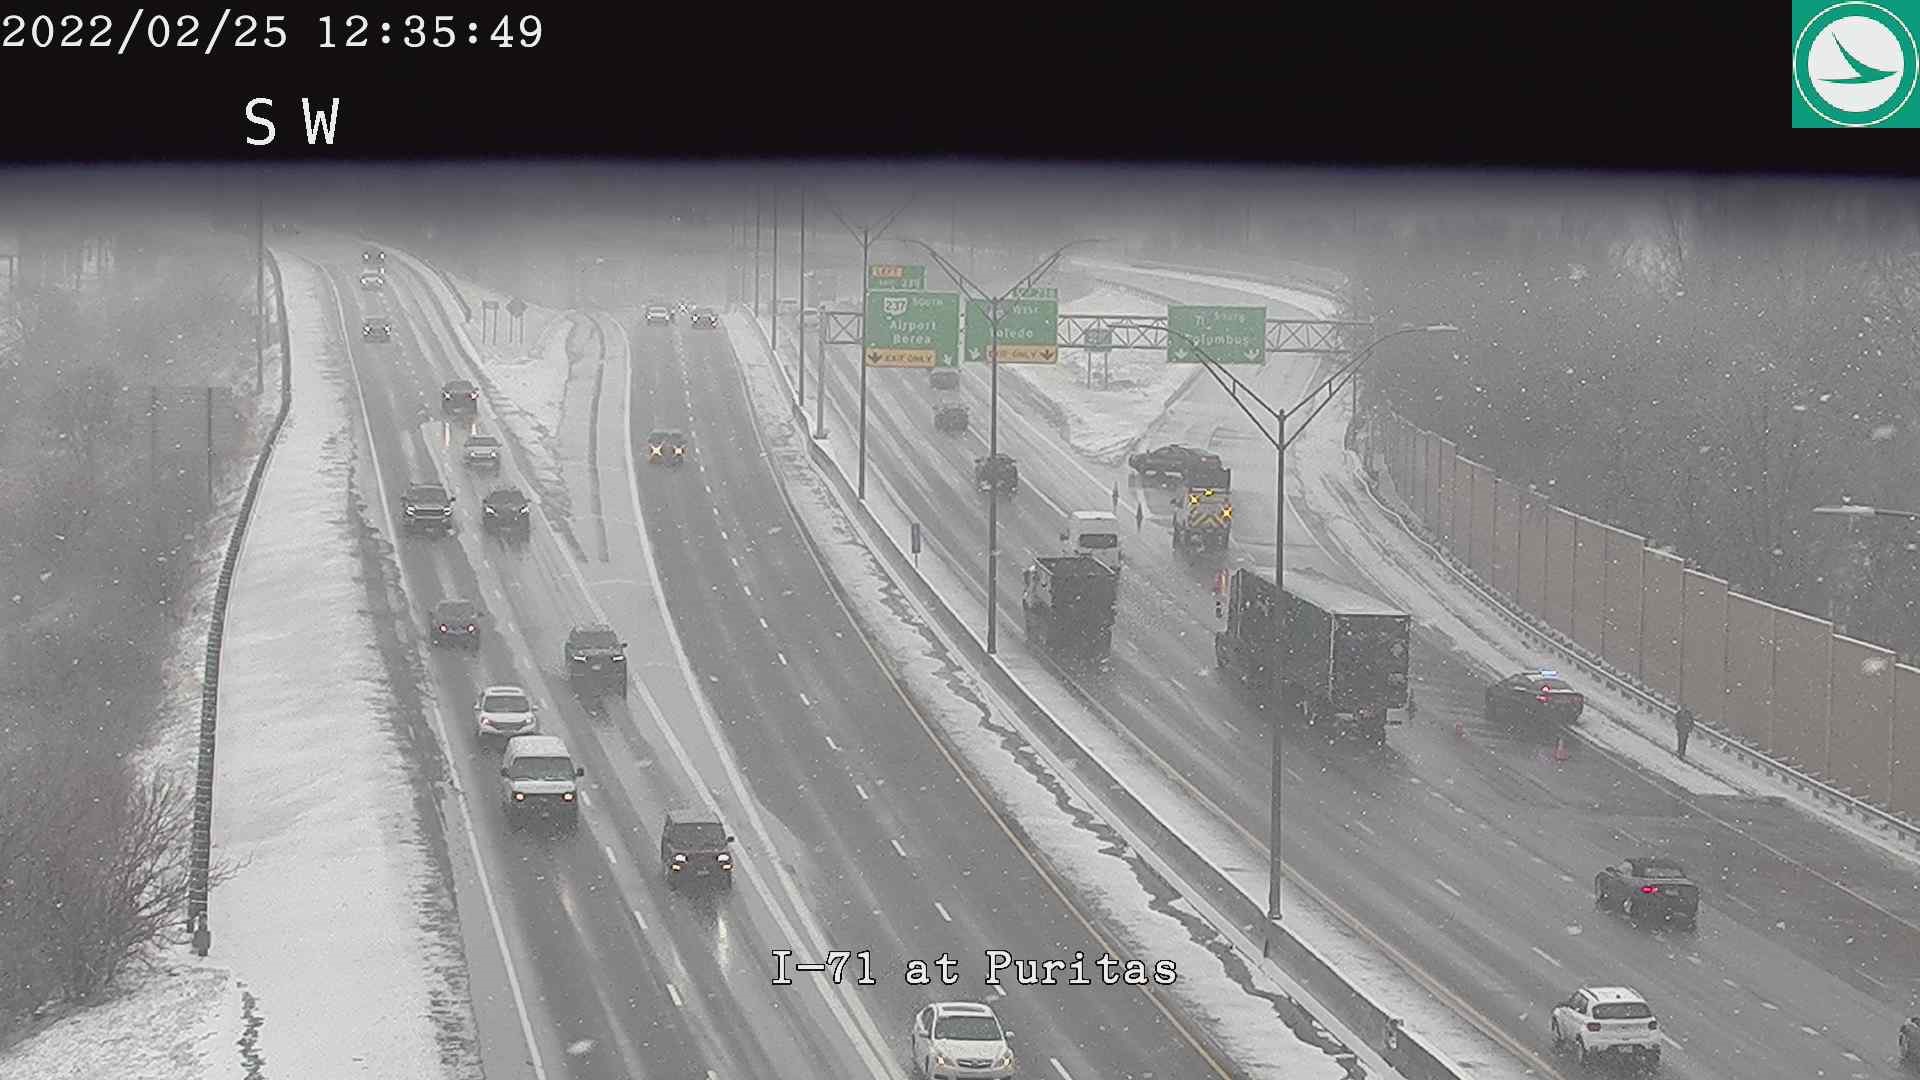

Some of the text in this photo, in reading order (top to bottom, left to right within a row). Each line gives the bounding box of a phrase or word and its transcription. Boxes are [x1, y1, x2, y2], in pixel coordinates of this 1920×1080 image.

[886, 300, 906, 312] 237
[888, 319, 936, 333] Airport
[892, 334, 931, 345] Berea
